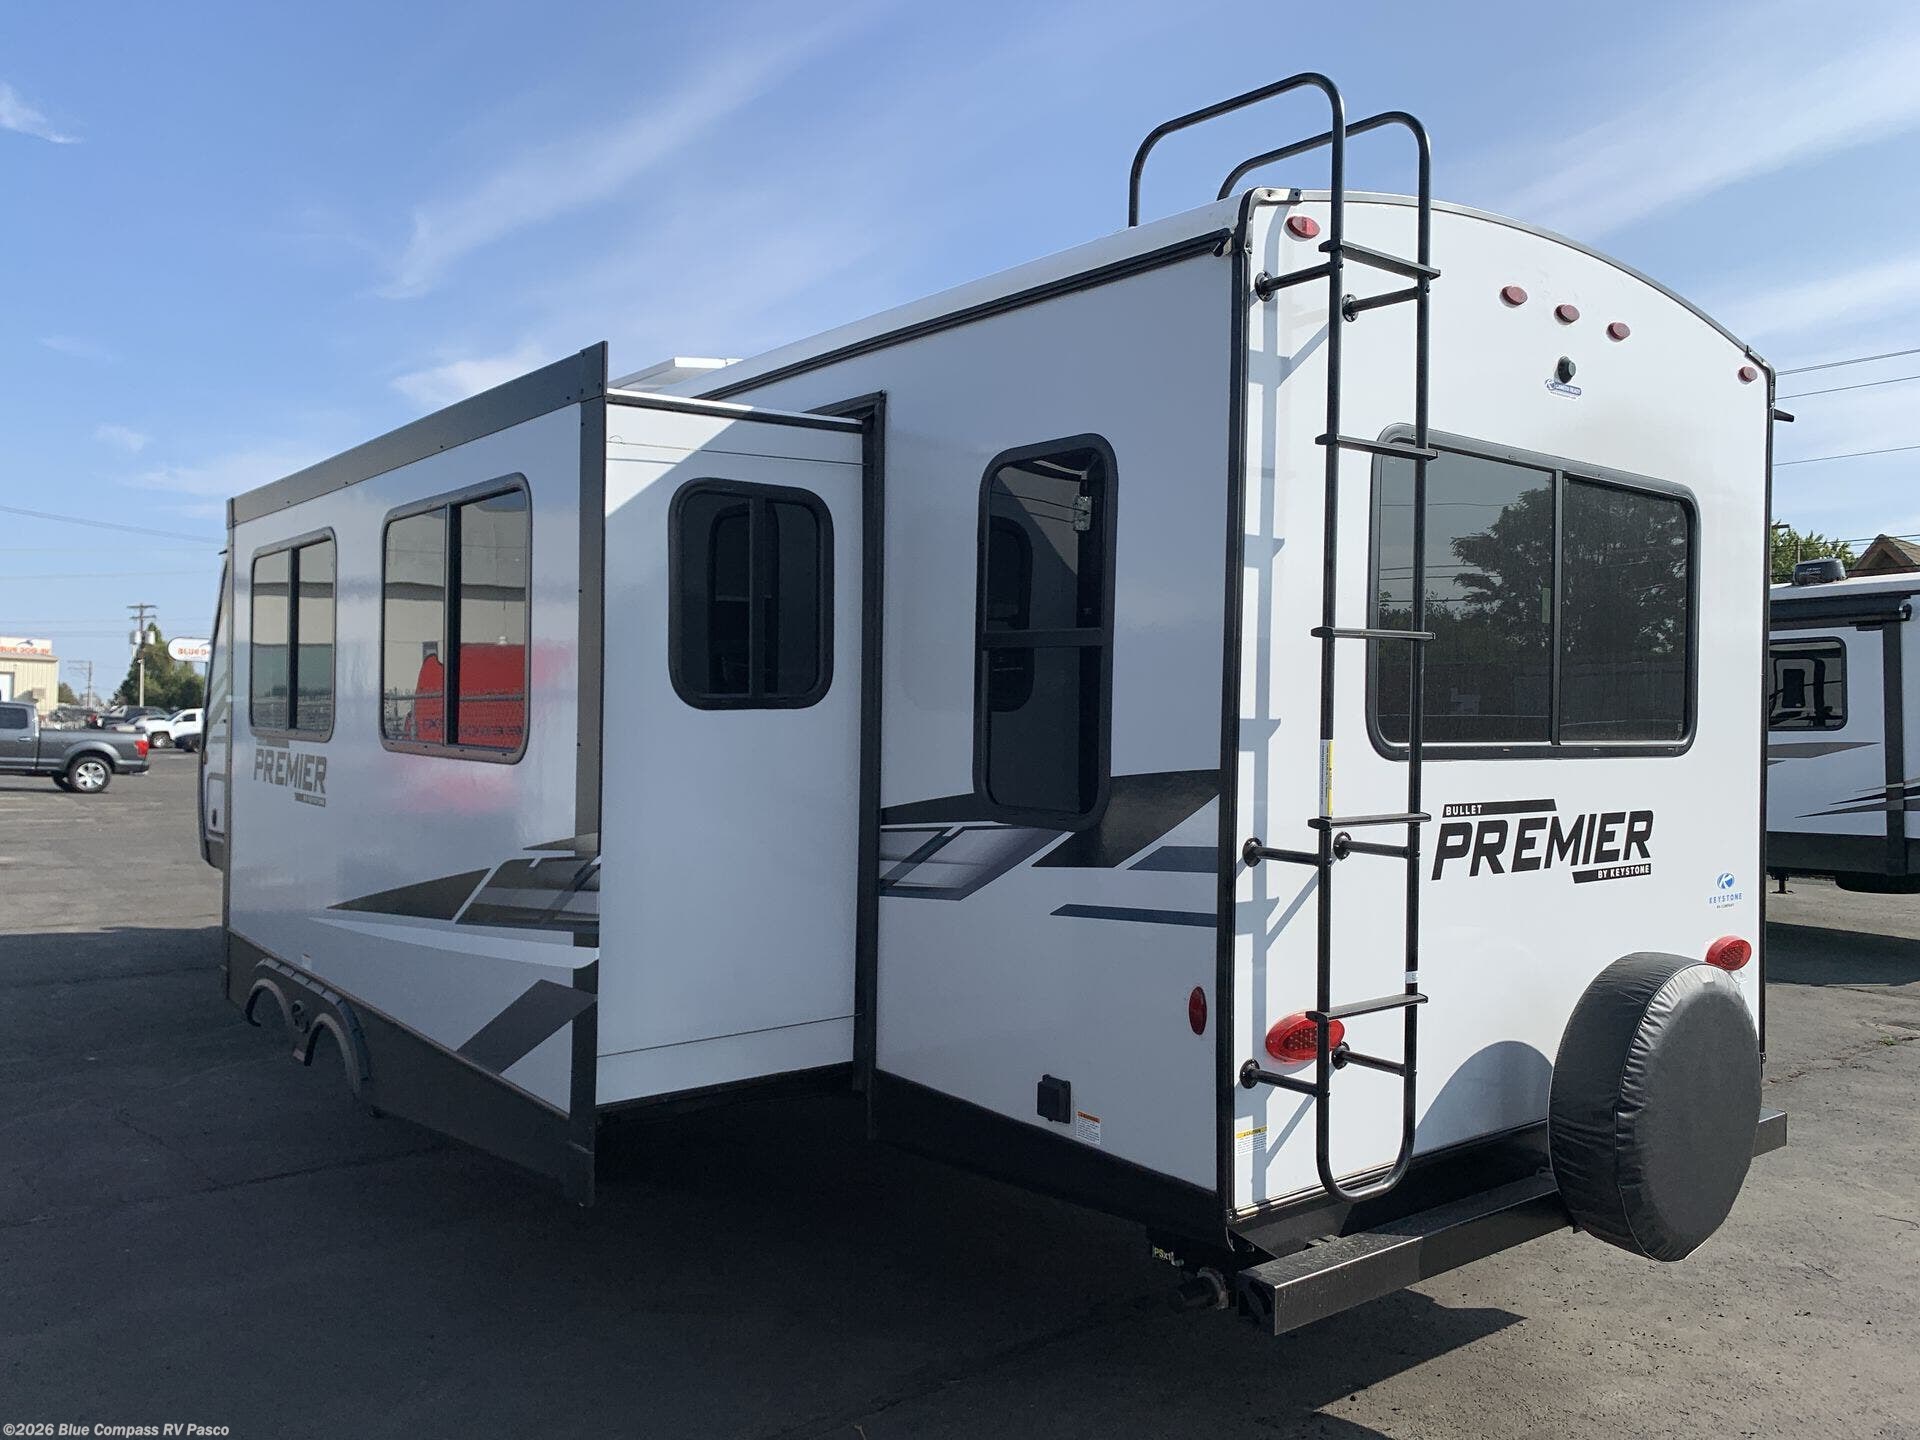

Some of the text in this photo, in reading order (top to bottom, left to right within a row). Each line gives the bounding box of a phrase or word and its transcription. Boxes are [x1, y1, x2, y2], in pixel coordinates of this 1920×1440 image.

[254, 748, 327, 794] PREMIER
[1445, 804, 1482, 816] BULLET
[1431, 810, 1654, 881] PREMIER
[1598, 864, 1650, 879] BY KEYSTONE
[1708, 892, 1743, 904] KEYSTONE
